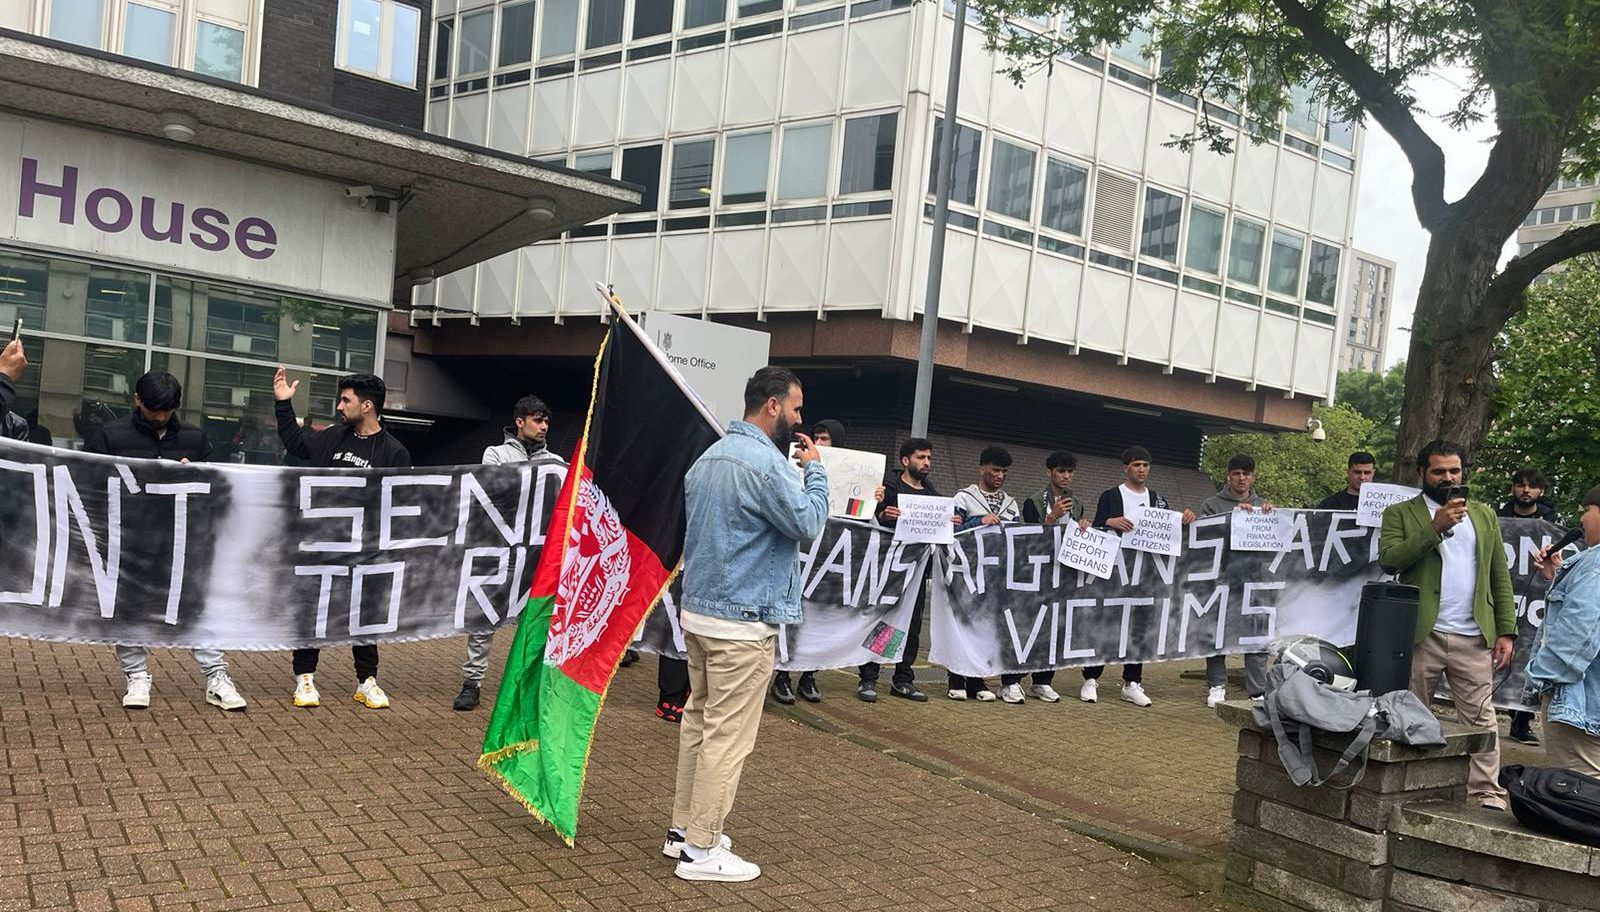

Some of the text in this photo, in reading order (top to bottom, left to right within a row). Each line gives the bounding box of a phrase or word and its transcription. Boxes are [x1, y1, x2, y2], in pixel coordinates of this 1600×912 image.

[18, 157, 278, 260] House
[667, 353, 716, 370] ome Office
[1367, 491, 1393, 500] DON'T
[905, 503, 934, 511] AFGHANS
[1362, 500, 1388, 509] AFGH
[909, 511, 943, 520] VICTIMS OF
[1144, 509, 1171, 520] DON'T
[902, 519, 946, 528] INTERNATIONAL
[1138, 519, 1173, 532] IGNORE
[299, 464, 569, 553] SEND
[799, 528, 918, 607] HANS
[911, 527, 937, 535] POLITICS
[1074, 527, 1106, 545] DON'T
[1134, 529, 1171, 541] AFGHAN
[1246, 533, 1277, 541] RWANDA
[1065, 537, 1109, 560] DEPORT
[1131, 538, 1171, 552] CITIZENS
[1238, 541, 1284, 549] LEGISLATION
[1061, 549, 1108, 574] AFGHANS
[295, 561, 405, 638] TO
[1004, 581, 1286, 665] VICTIMS
